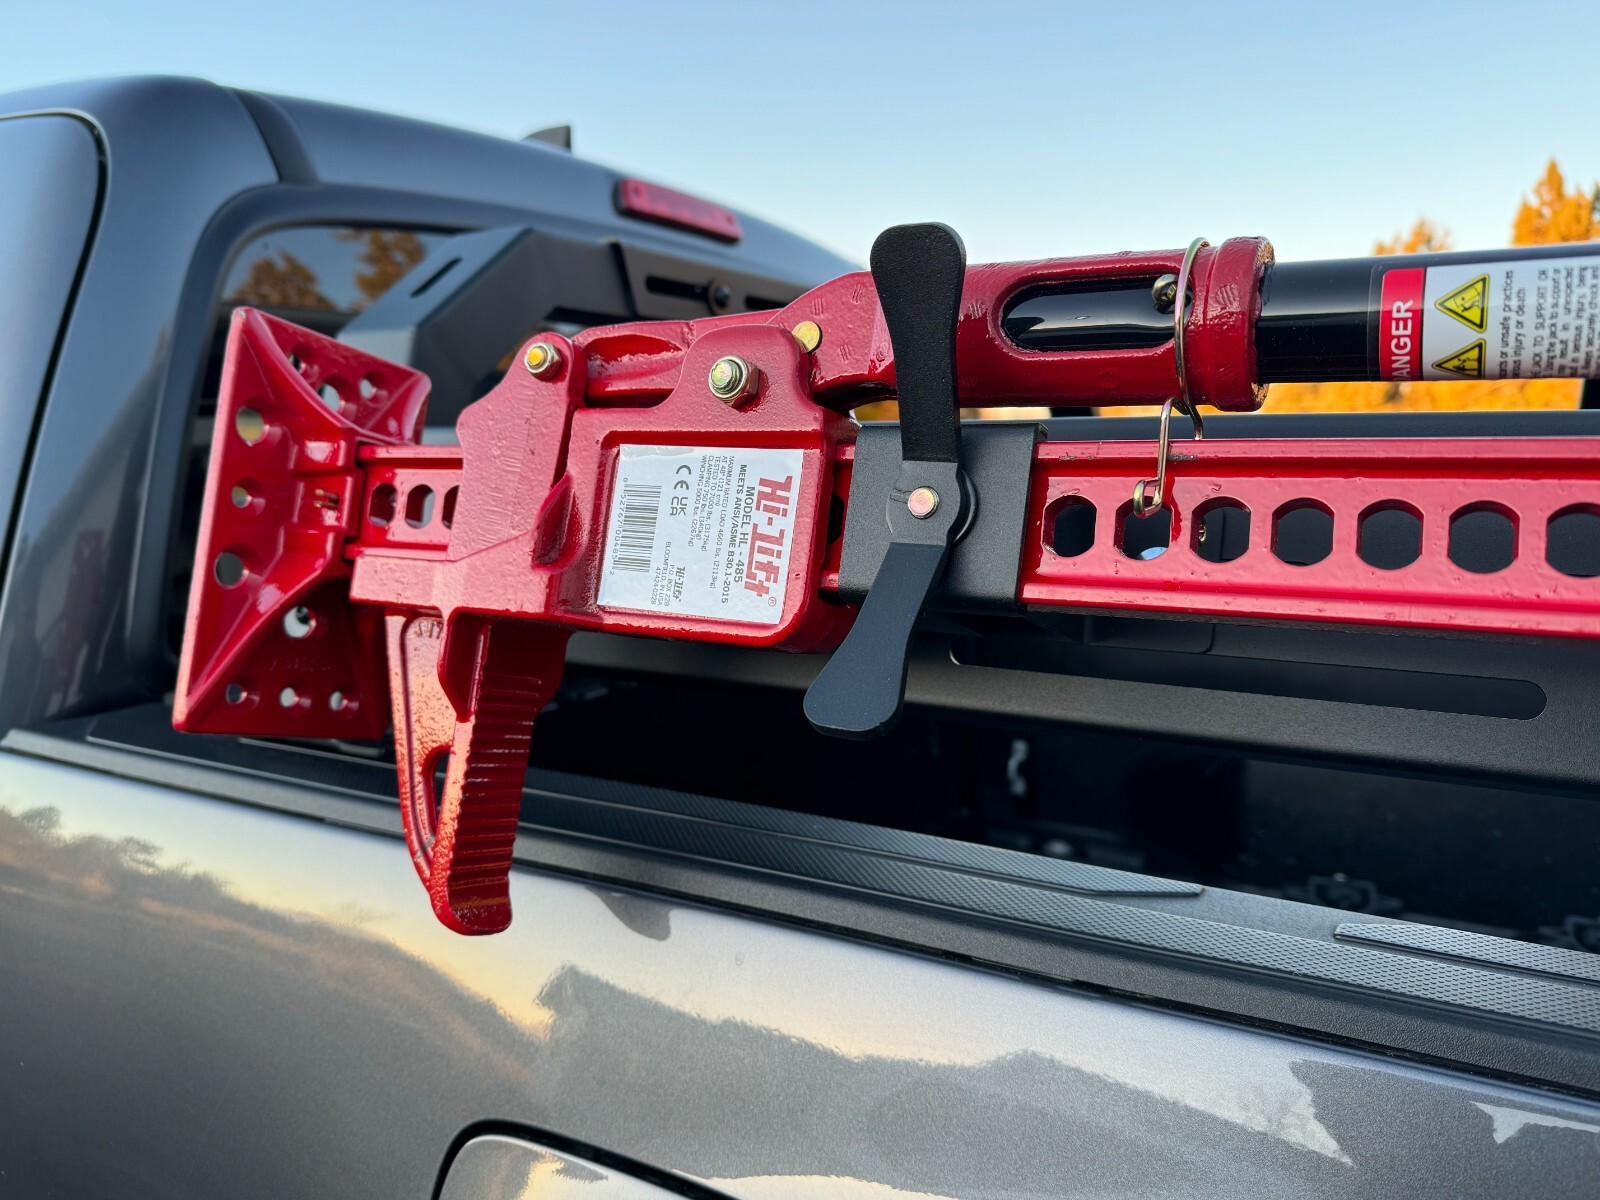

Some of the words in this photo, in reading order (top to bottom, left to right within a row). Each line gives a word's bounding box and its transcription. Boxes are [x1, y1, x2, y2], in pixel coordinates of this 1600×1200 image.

[1502, 270, 1514, 312] practices
[1515, 288, 1525, 316] death
[1534, 286, 1549, 330] SUPPORT
[1499, 316, 1511, 348] unsafe
[1515, 320, 1523, 329] or
[1511, 333, 1525, 357] injury
[1532, 335, 1544, 348] TO
[698, 455, 708, 486] WINCHING
[704, 455, 714, 487] CLAMPING
[712, 456, 721, 480] TESTED
[725, 456, 734, 486] MAXIMUM
[737, 465, 747, 494] MEETS
[711, 482, 717, 491] TO
[722, 488, 730, 508] RATED
[618, 494, 626, 524] 52767
[670, 496, 679, 516] CA
[678, 497, 688, 516] UK
[741, 486, 755, 528] MODEL
[688, 519, 698, 547] (2267kg)
[696, 516, 705, 540] (340kg)
[729, 497, 742, 548] ANSI/ASME
[612, 530, 622, 560] 00485
[701, 524, 710, 552] (3175kg)
[738, 532, 749, 547] HL
[660, 541, 671, 582] BLOOMFIELD,
[710, 560, 720, 589] (2113kg)
[734, 560, 744, 583] 485
[651, 567, 661, 605] 47424-0228
[721, 551, 734, 604] B30.1-2015
